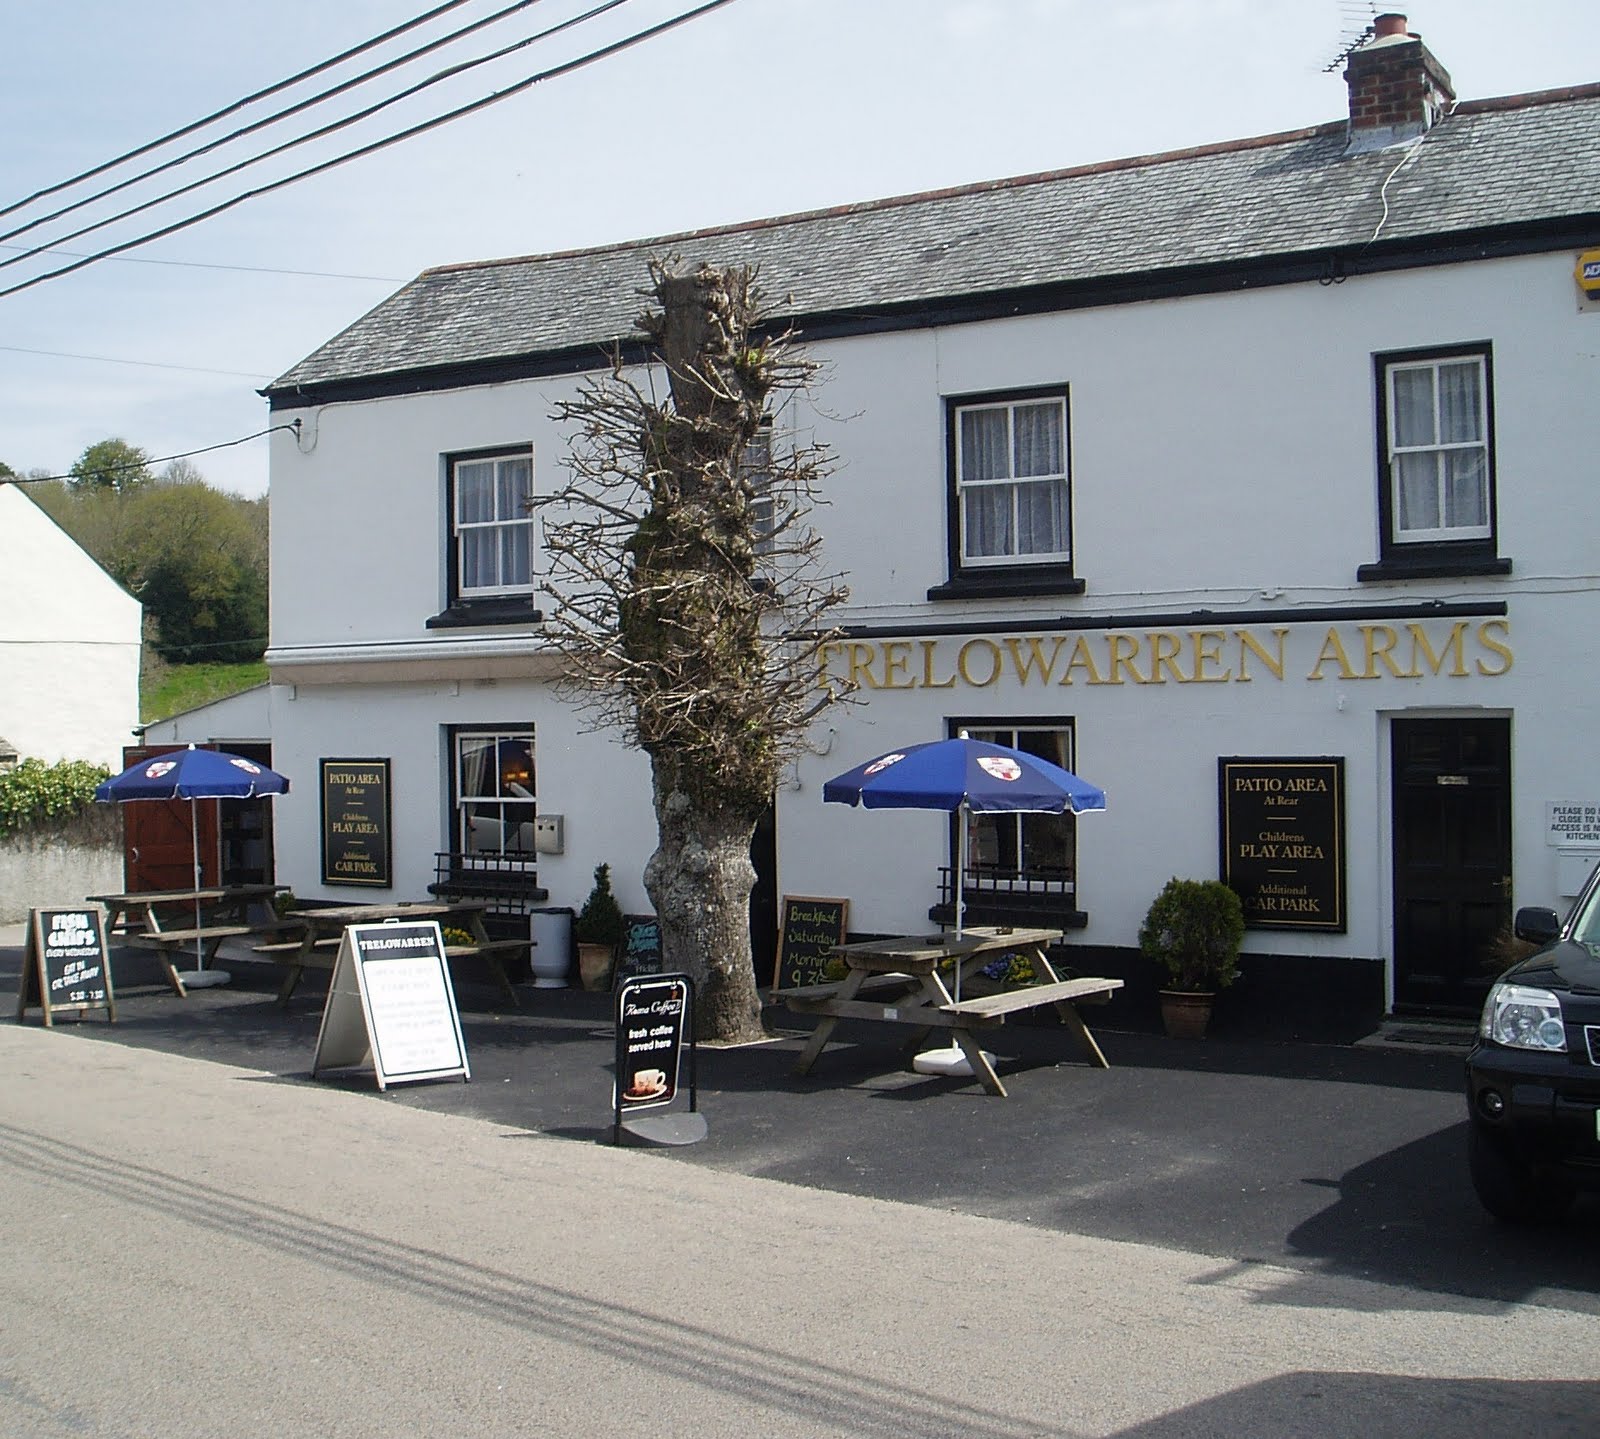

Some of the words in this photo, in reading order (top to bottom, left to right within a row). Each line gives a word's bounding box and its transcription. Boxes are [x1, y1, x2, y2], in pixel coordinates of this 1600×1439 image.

[814, 628, 1290, 690] TRELOWARREN
[1307, 619, 1514, 681] ARMS
[329, 773, 356, 784] PATIO
[357, 774, 381, 784] AREA
[1235, 778, 1282, 792] PATIO
[1285, 778, 1328, 792] AREA
[345, 787, 352, 795] At
[353, 787, 365, 795] Rear
[1264, 796, 1276, 806] At
[1277, 796, 1299, 806] Rear
[342, 813, 369, 821] Childrens
[332, 822, 355, 833] PLAY
[355, 823, 379, 833] AREA
[1258, 832, 1305, 842] Childrens
[342, 852, 370, 860] Additional
[1240, 844, 1279, 858] PLAY
[1281, 845, 1325, 859] AREA
[335, 862, 354, 872] CAR
[355, 862, 377, 873] PARK
[1258, 884, 1307, 895] Additional
[1280, 898, 1320, 912] PARK
[52, 913, 89, 930] FISH
[790, 906, 837, 926] Breakfast
[48, 930, 95, 947] CHIPS
[359, 936, 435, 951] TRELOWARREN
[788, 928, 836, 953] Saturday
[651, 1001, 676, 1016] Coffee
[628, 1028, 648, 1039] fresh
[650, 1025, 674, 1036] coffee
[628, 1040, 654, 1053] served
[655, 1040, 672, 1049] here
